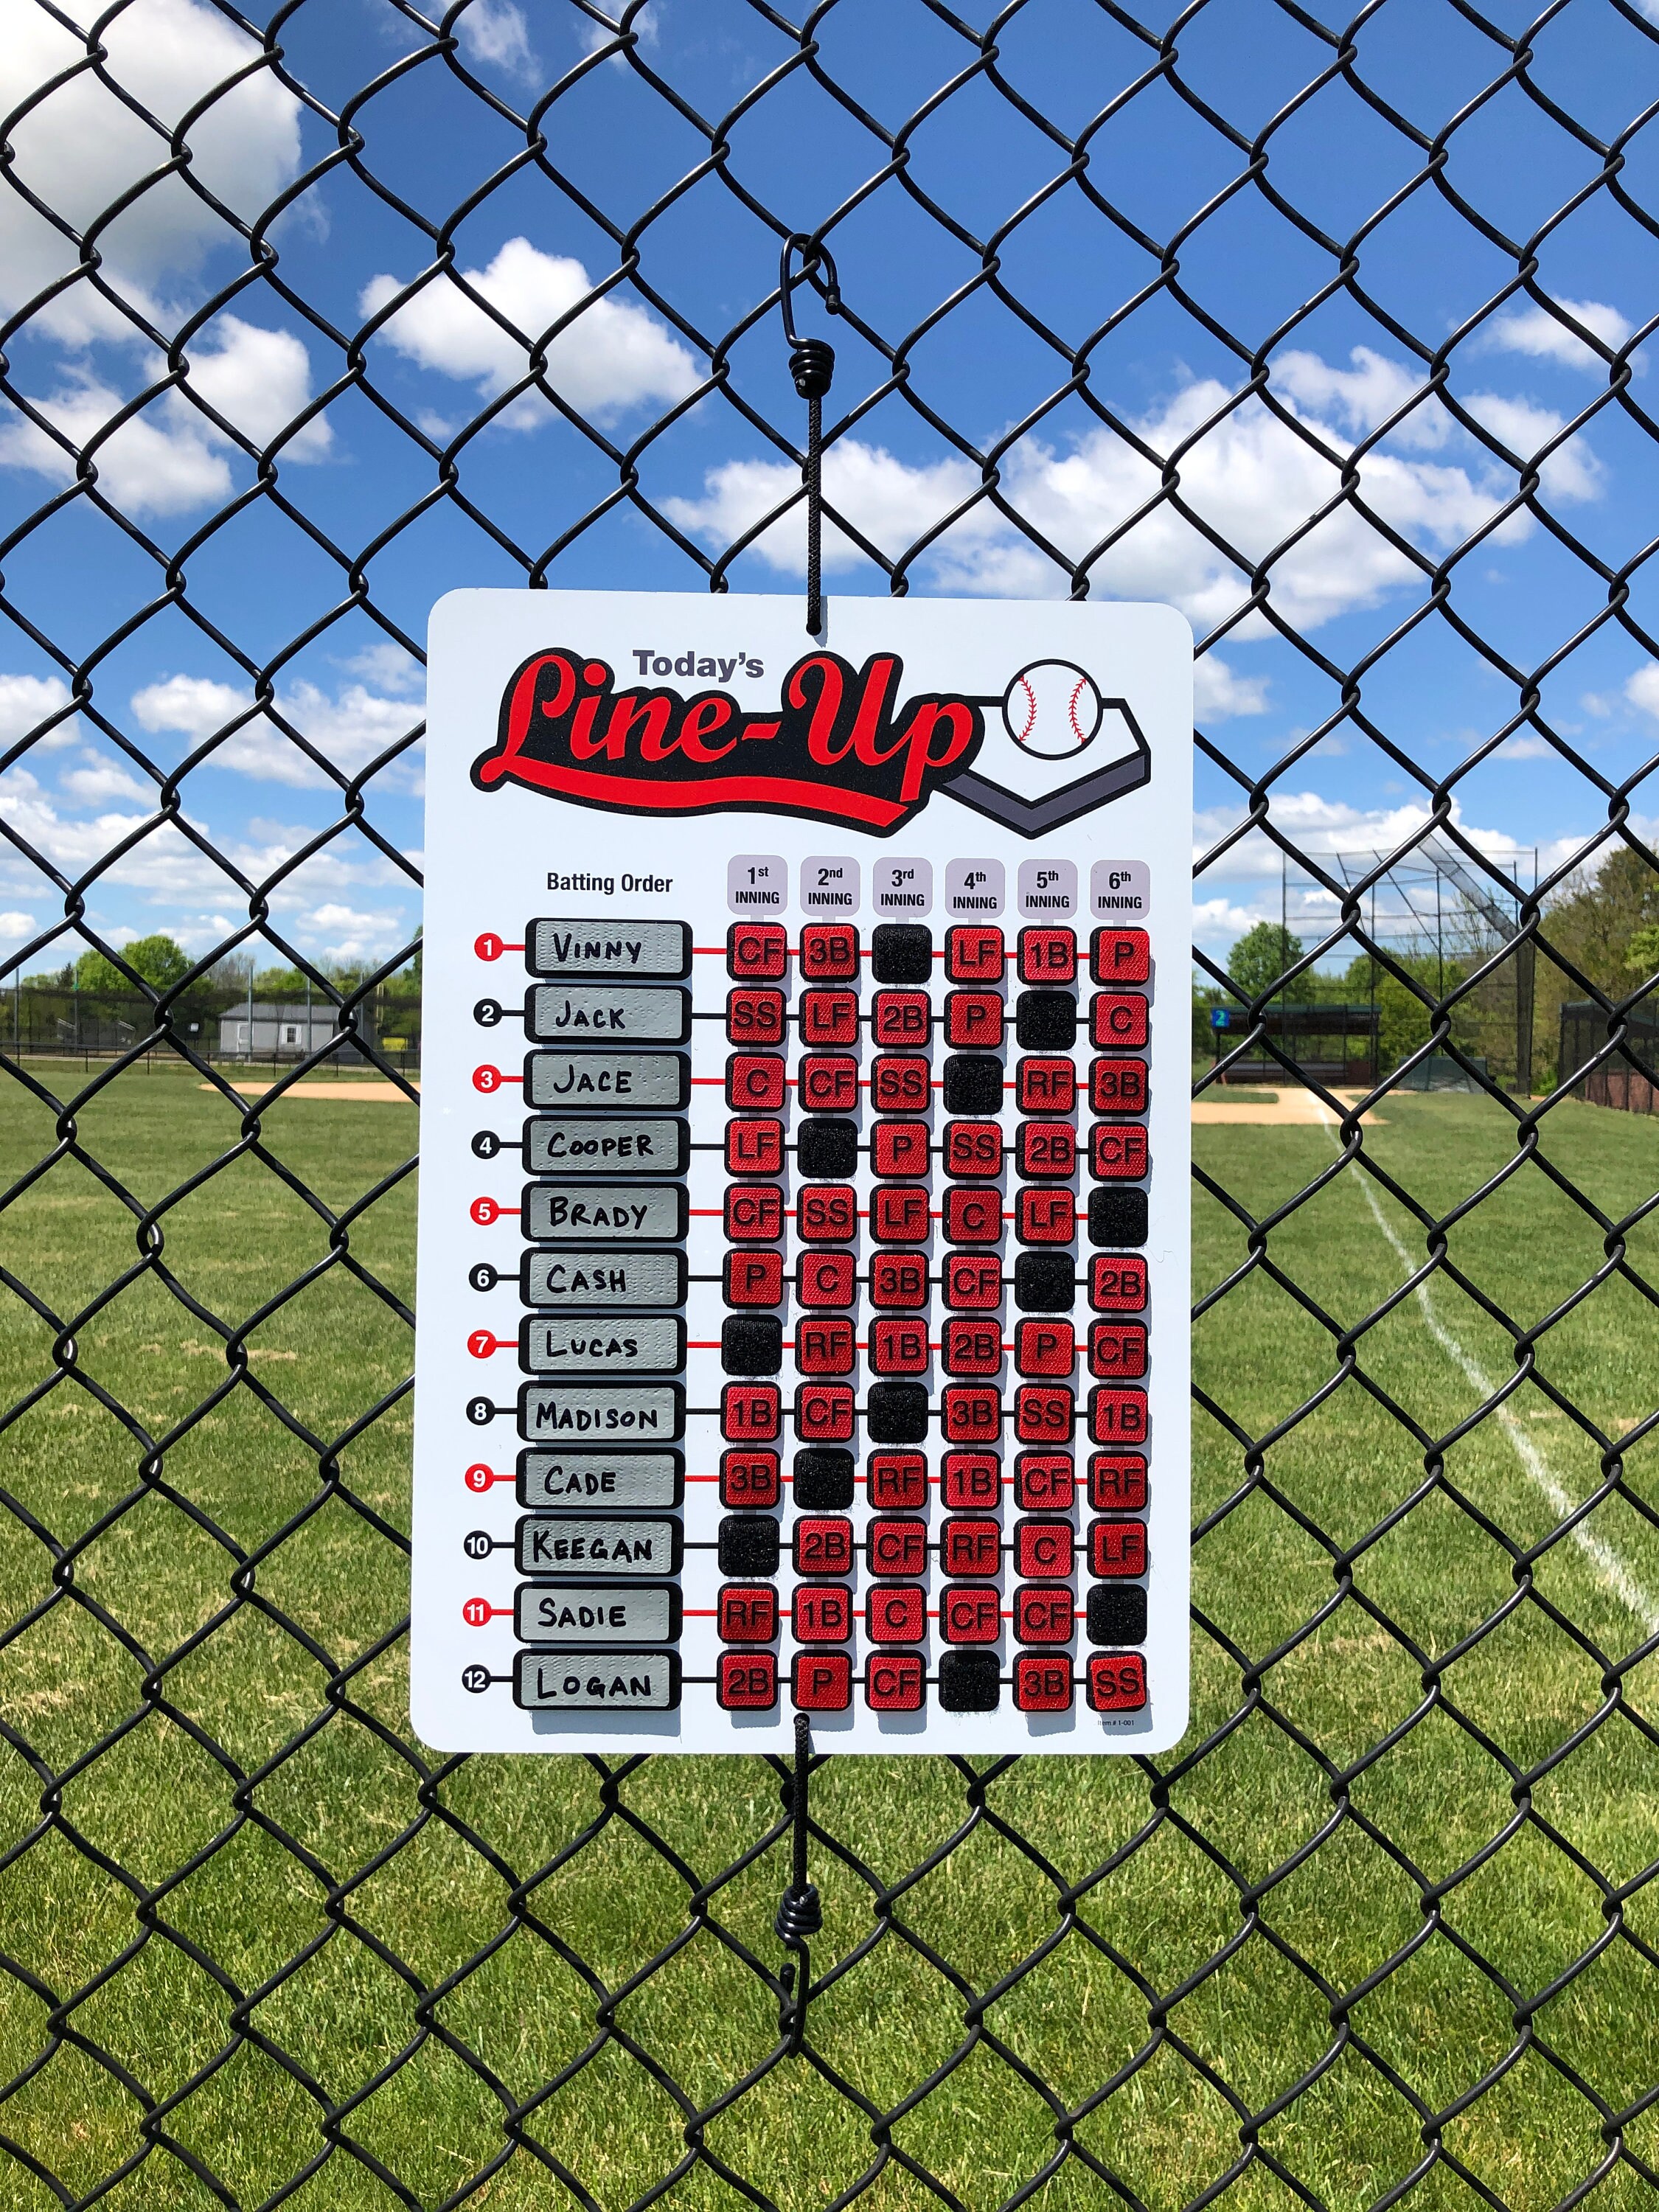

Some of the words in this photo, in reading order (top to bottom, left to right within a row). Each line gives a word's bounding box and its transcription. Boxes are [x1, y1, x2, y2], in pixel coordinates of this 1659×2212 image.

[633, 649, 765, 680] Today's
[547, 872, 614, 894] Batting
[622, 874, 672, 892] Order
[748, 866, 769, 884] 1st
[818, 868, 843, 886] 2nd
[891, 869, 914, 886] 3rd
[964, 871, 987, 888] 4th
[1037, 871, 1059, 888] 5th
[1109, 872, 1131, 889] 6th
[736, 891, 779, 905] INNING
[808, 892, 852, 905] INNING
[880, 894, 925, 907] INNING
[953, 896, 997, 910] INNING
[1026, 894, 1070, 908] INNING
[1098, 896, 1141, 909] INNING
[484, 939, 493, 956] 1
[552, 933, 641, 964] VINNY
[738, 937, 782, 963] CF
[809, 937, 849, 964] 3B
[959, 939, 997, 966] LF
[1032, 942, 1069, 968] 1B
[1114, 942, 1135, 967] P
[481, 1005, 494, 1021] 2
[555, 1000, 625, 1029] JACK
[734, 1001, 776, 1028] SS
[813, 1003, 850, 1027] LF
[885, 1005, 922, 1032] 2B
[967, 1005, 986, 1029] P
[1110, 1006, 1133, 1032] C
[480, 1071, 493, 1088] 3
[553, 1064, 632, 1093] JACE
[747, 1068, 770, 1096] C
[810, 1070, 853, 1096] CF
[880, 1069, 922, 1096] SS
[1028, 1071, 1069, 1096] RF
[1100, 1071, 1140, 1097] 3B
[479, 1137, 492, 1153] 4
[547, 1132, 654, 1158] COOPER
[738, 1132, 774, 1158] LF
[893, 1135, 912, 1161] P
[953, 1133, 995, 1160] SS
[1032, 1136, 1070, 1162] 2B
[1099, 1137, 1142, 1163] CF
[478, 1203, 491, 1220] 5
[549, 1196, 647, 1229] BRADY
[733, 1198, 776, 1225] CF
[806, 1199, 848, 1225] SS
[886, 1199, 922, 1225] LF
[962, 1203, 985, 1230] C
[1032, 1201, 1068, 1227] LF
[477, 1270, 489, 1286] 6
[546, 1265, 626, 1293] CASH
[747, 1265, 765, 1290] P
[817, 1265, 839, 1292] C
[880, 1267, 920, 1293] 3B
[953, 1269, 998, 1295] CF
[1101, 1270, 1140, 1297] 2B
[476, 1336, 488, 1353] 7
[546, 1331, 638, 1357] LUCAS
[807, 1332, 849, 1357] RF
[884, 1334, 921, 1360] 1B
[955, 1334, 994, 1360] 2B
[1037, 1333, 1056, 1358] P
[1097, 1337, 1141, 1363] CF
[474, 1403, 487, 1419] 8
[536, 1401, 658, 1430] MADISON
[734, 1400, 772, 1427] 1B
[806, 1397, 850, 1425] CF
[952, 1400, 992, 1427] 3B
[1023, 1400, 1065, 1427] SS
[1104, 1404, 1140, 1430] 1B
[473, 1470, 485, 1486] 9
[544, 1466, 616, 1495] CADE
[730, 1464, 771, 1492] 3B
[878, 1467, 922, 1493] RF
[956, 1467, 991, 1494] 1B
[1025, 1468, 1069, 1495] CF
[1099, 1468, 1141, 1494] RF
[467, 1537, 488, 1554] 10
[533, 1530, 652, 1562] KEEGAN
[805, 1531, 844, 1559] 2B
[877, 1533, 925, 1561] CF
[953, 1534, 996, 1560] RF
[1034, 1537, 1057, 1565] C
[1103, 1534, 1139, 1561] LF
[467, 1604, 484, 1621] 11
[538, 1597, 626, 1628] SADIE
[727, 1600, 771, 1626] RF
[803, 1600, 841, 1626] 1B
[886, 1600, 908, 1627] C
[951, 1602, 995, 1631] CF
[1024, 1601, 1068, 1630] CF
[465, 1670, 486, 1688] 12
[537, 1668, 650, 1699] LOGAN
[728, 1669, 769, 1695] 2B
[815, 1669, 832, 1694] P
[873, 1669, 918, 1696] CF
[1024, 1669, 1064, 1696] 3B
[1096, 1667, 1140, 1697] SS
